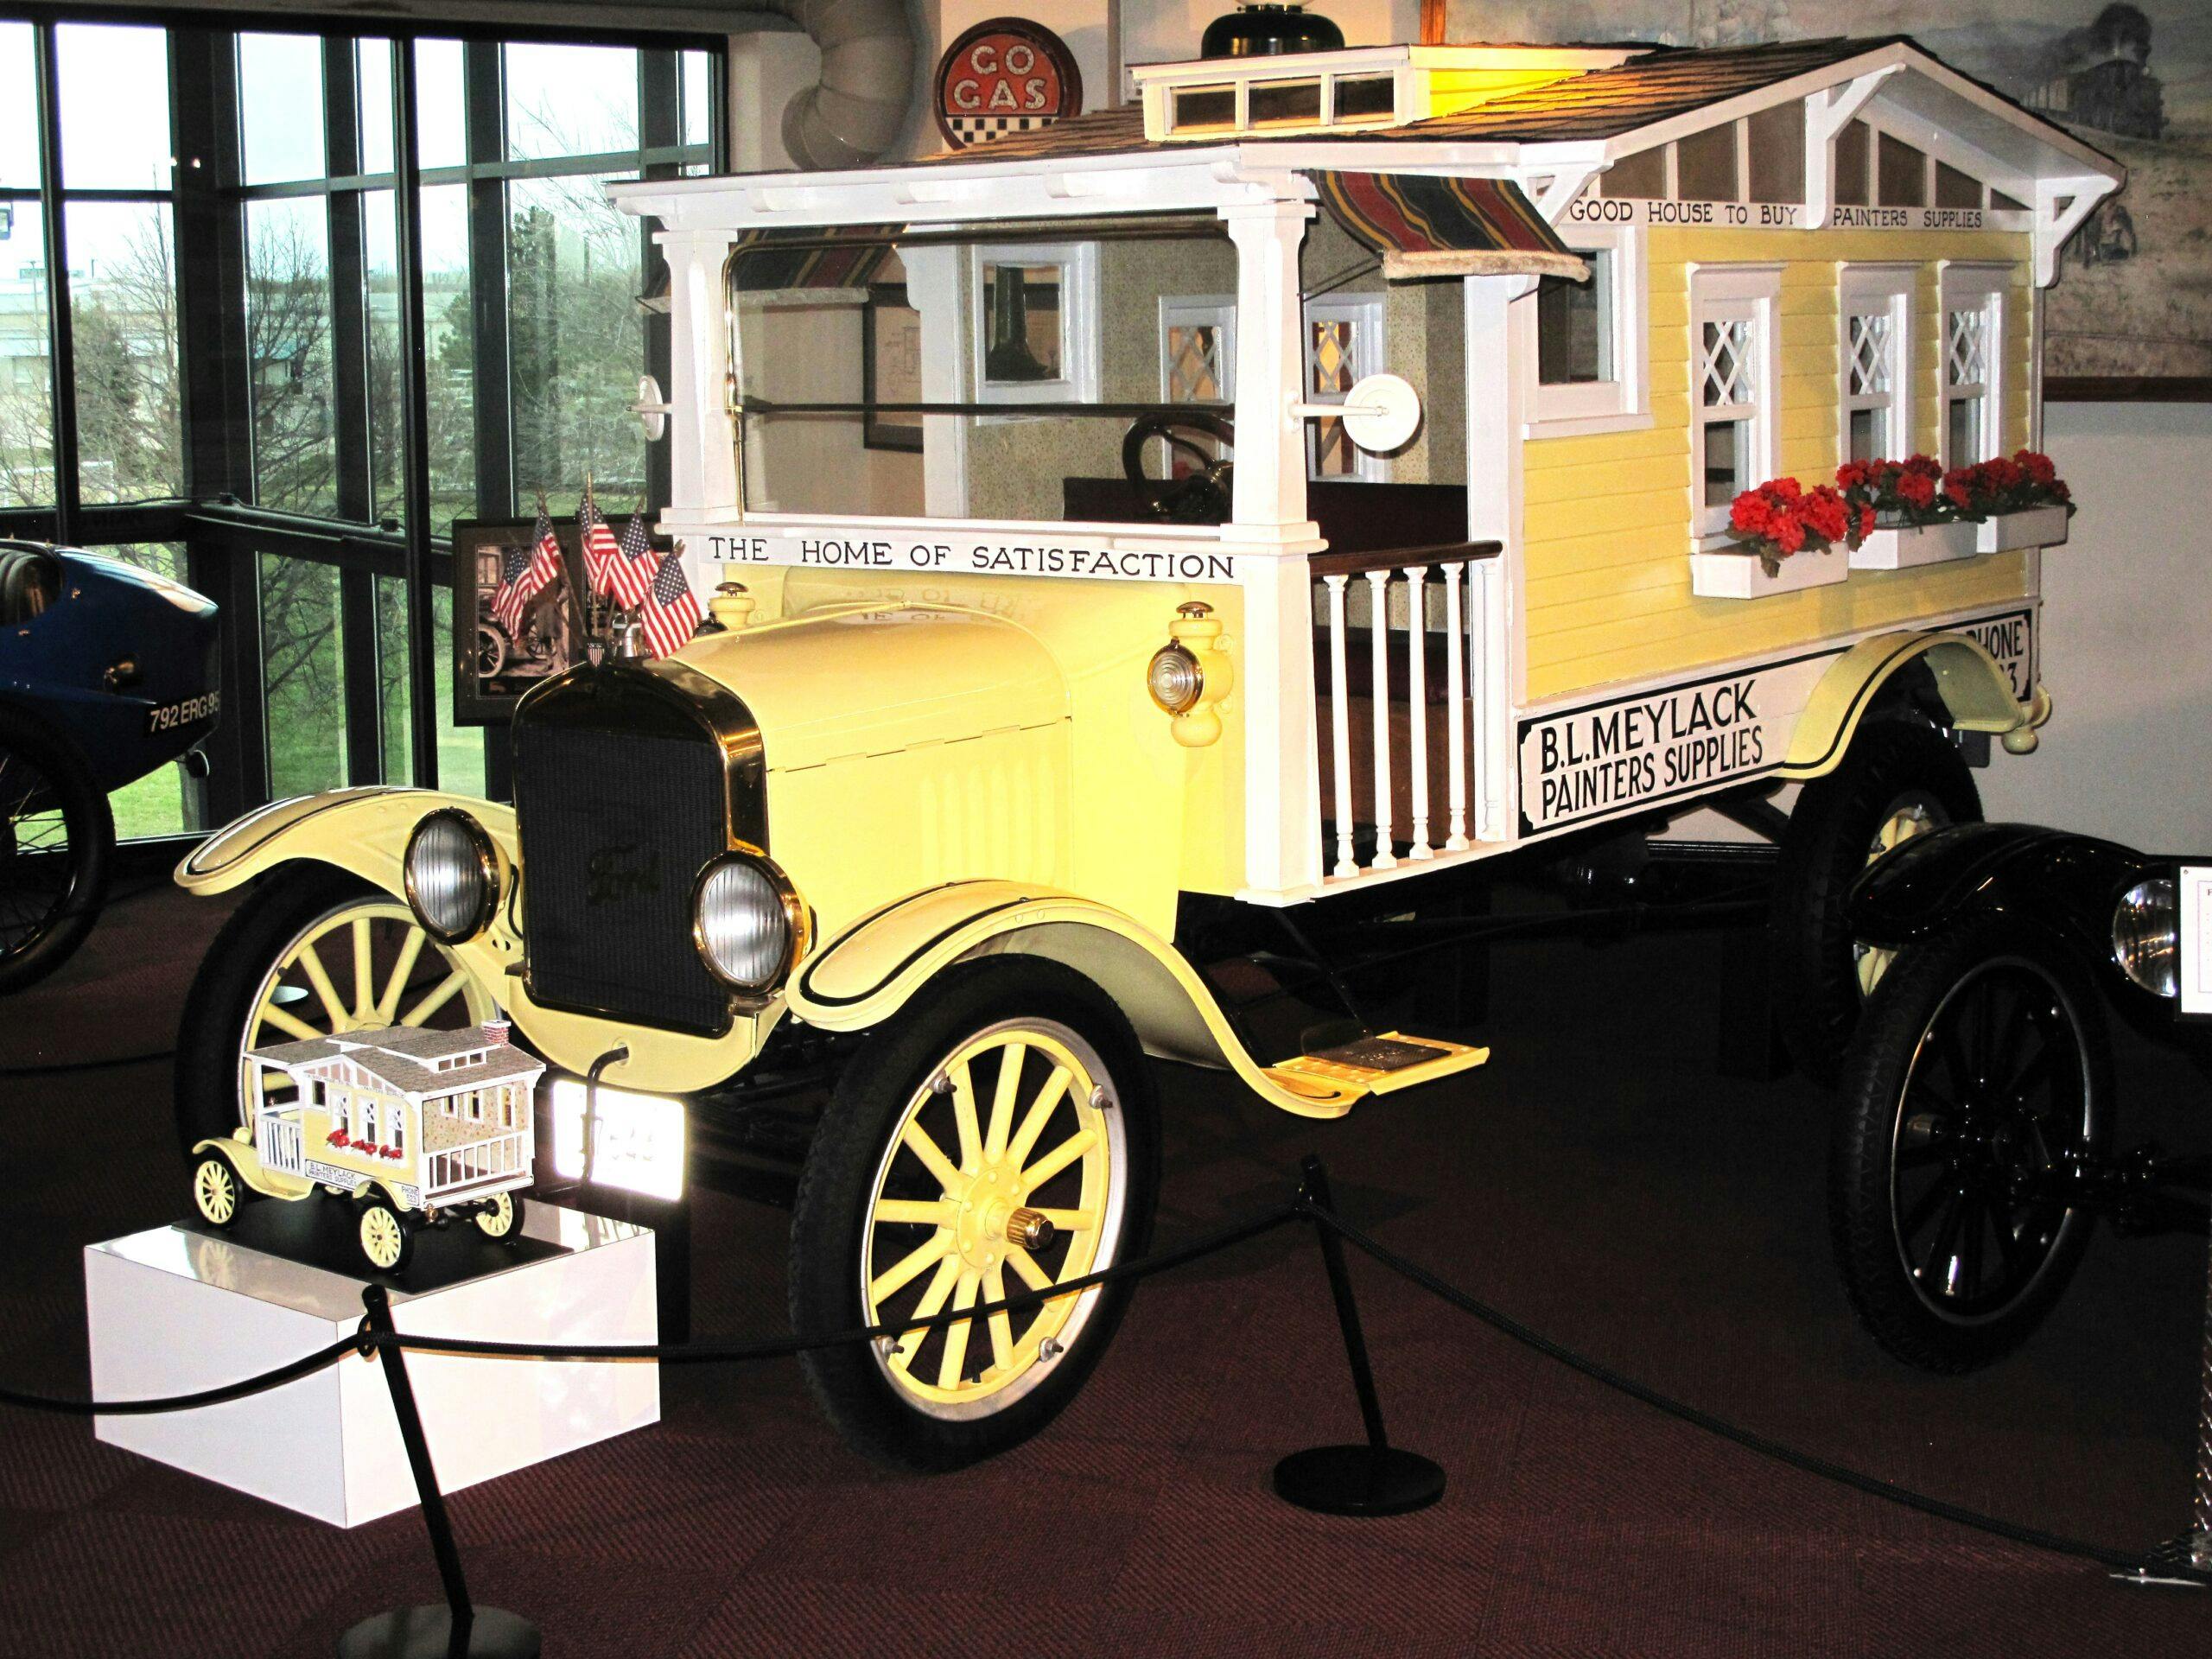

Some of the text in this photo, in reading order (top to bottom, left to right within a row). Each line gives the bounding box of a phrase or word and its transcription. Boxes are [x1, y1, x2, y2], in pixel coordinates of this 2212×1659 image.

[970, 45, 1034, 75] GO
[953, 79, 1047, 111] GAS
[1569, 200, 1797, 226] GOOD HOUSE TO BUY
[1833, 207, 1983, 228] PAINTERS SUPPLIES
[709, 537, 1234, 578] THE HOME OF SATISFACTION
[149, 705, 179, 733] 792
[181, 696, 207, 724] ERG
[1541, 725, 1763, 821] PAINTERS SUPPLIES
